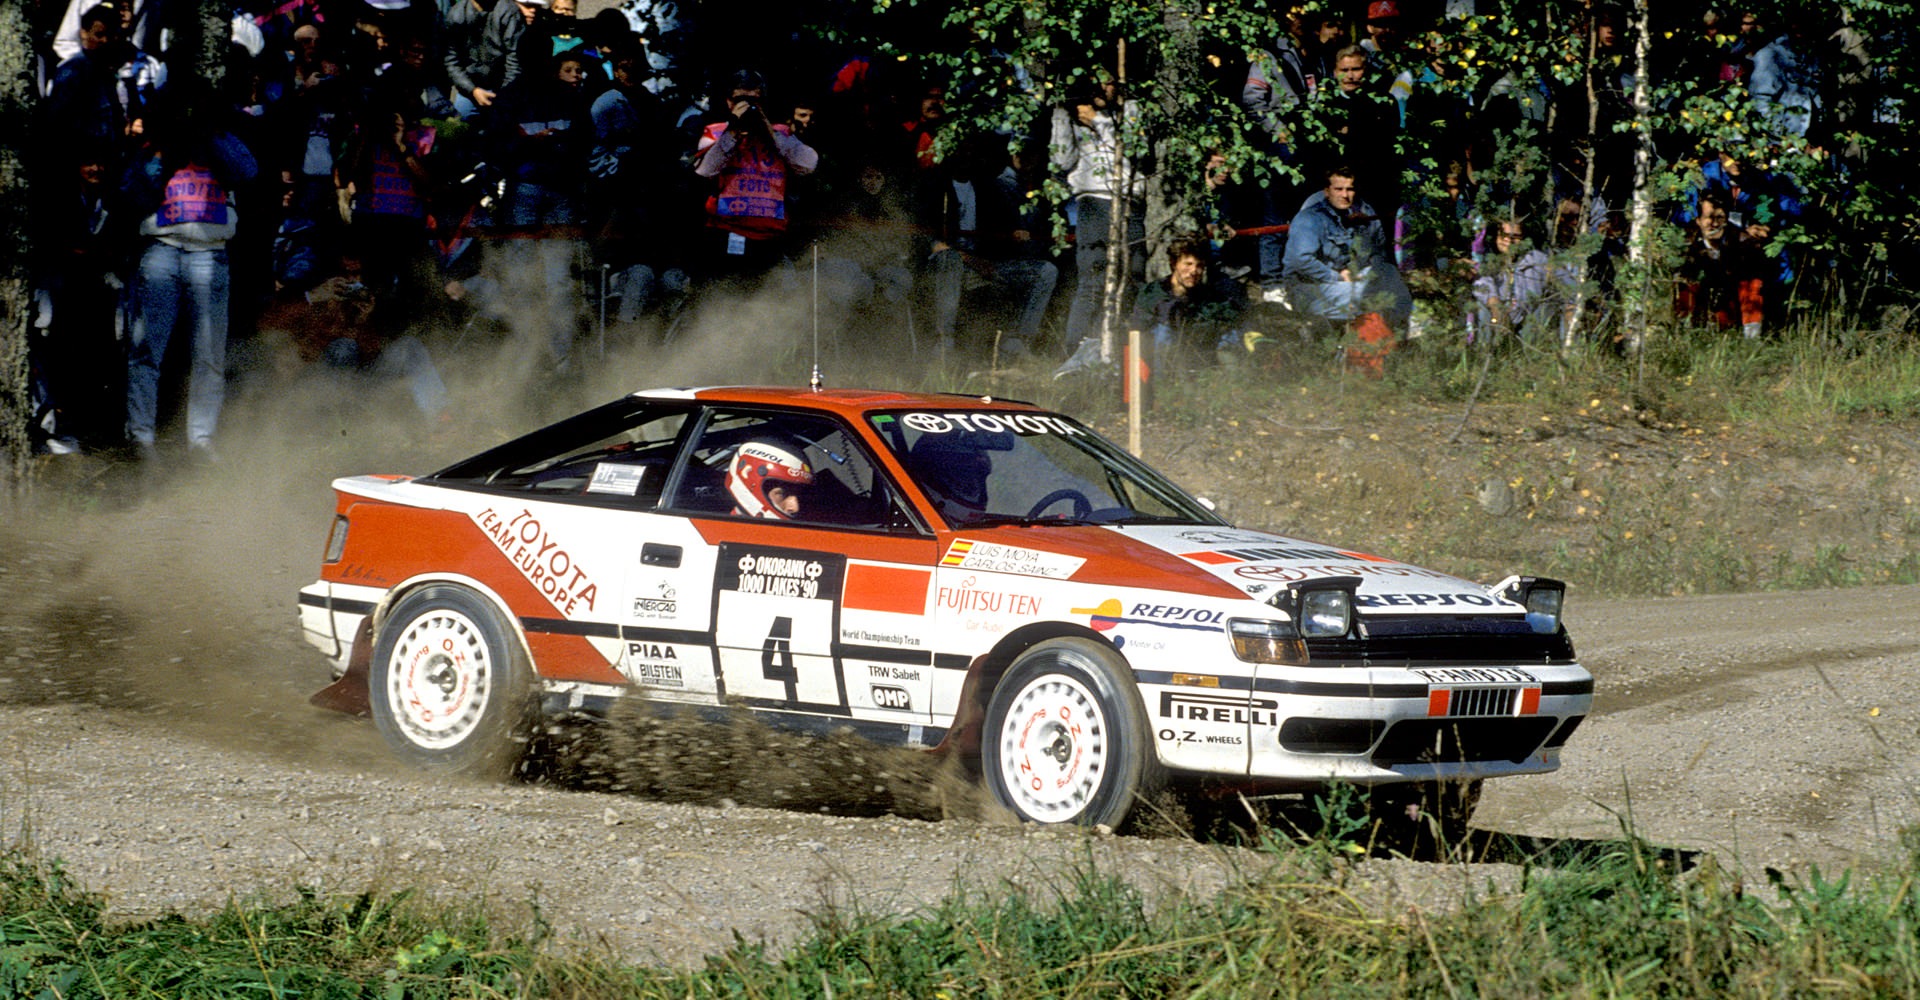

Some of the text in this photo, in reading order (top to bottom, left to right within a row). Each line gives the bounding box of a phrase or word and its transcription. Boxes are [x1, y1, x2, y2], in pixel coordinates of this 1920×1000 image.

[739, 178, 771, 193] FOTO
[943, 413, 1087, 437] TOYOTA
[744, 448, 784, 464] REPSOL
[477, 507, 577, 616] TEAM EUROPE
[509, 508, 598, 613] TOYOTA
[971, 543, 1040, 562] LUIS MOYA
[963, 556, 1059, 577] CARLOS SAINZ
[737, 573, 765, 593] 1000
[765, 576, 799, 597] LAKES
[937, 586, 1042, 616] FUJITSU TEN
[1355, 593, 1518, 608] REPSOL
[1129, 603, 1225, 624] REPSOL
[842, 629, 921, 646] World Championship Team
[628, 643, 678, 660] PIAA
[761, 615, 800, 701] 4
[639, 663, 683, 680] BILSTEIN
[868, 665, 921, 681] TRW Sabelt
[873, 688, 910, 708] OMP
[1160, 690, 1278, 727] PIRELLI
[1206, 735, 1243, 745] WHEELS
